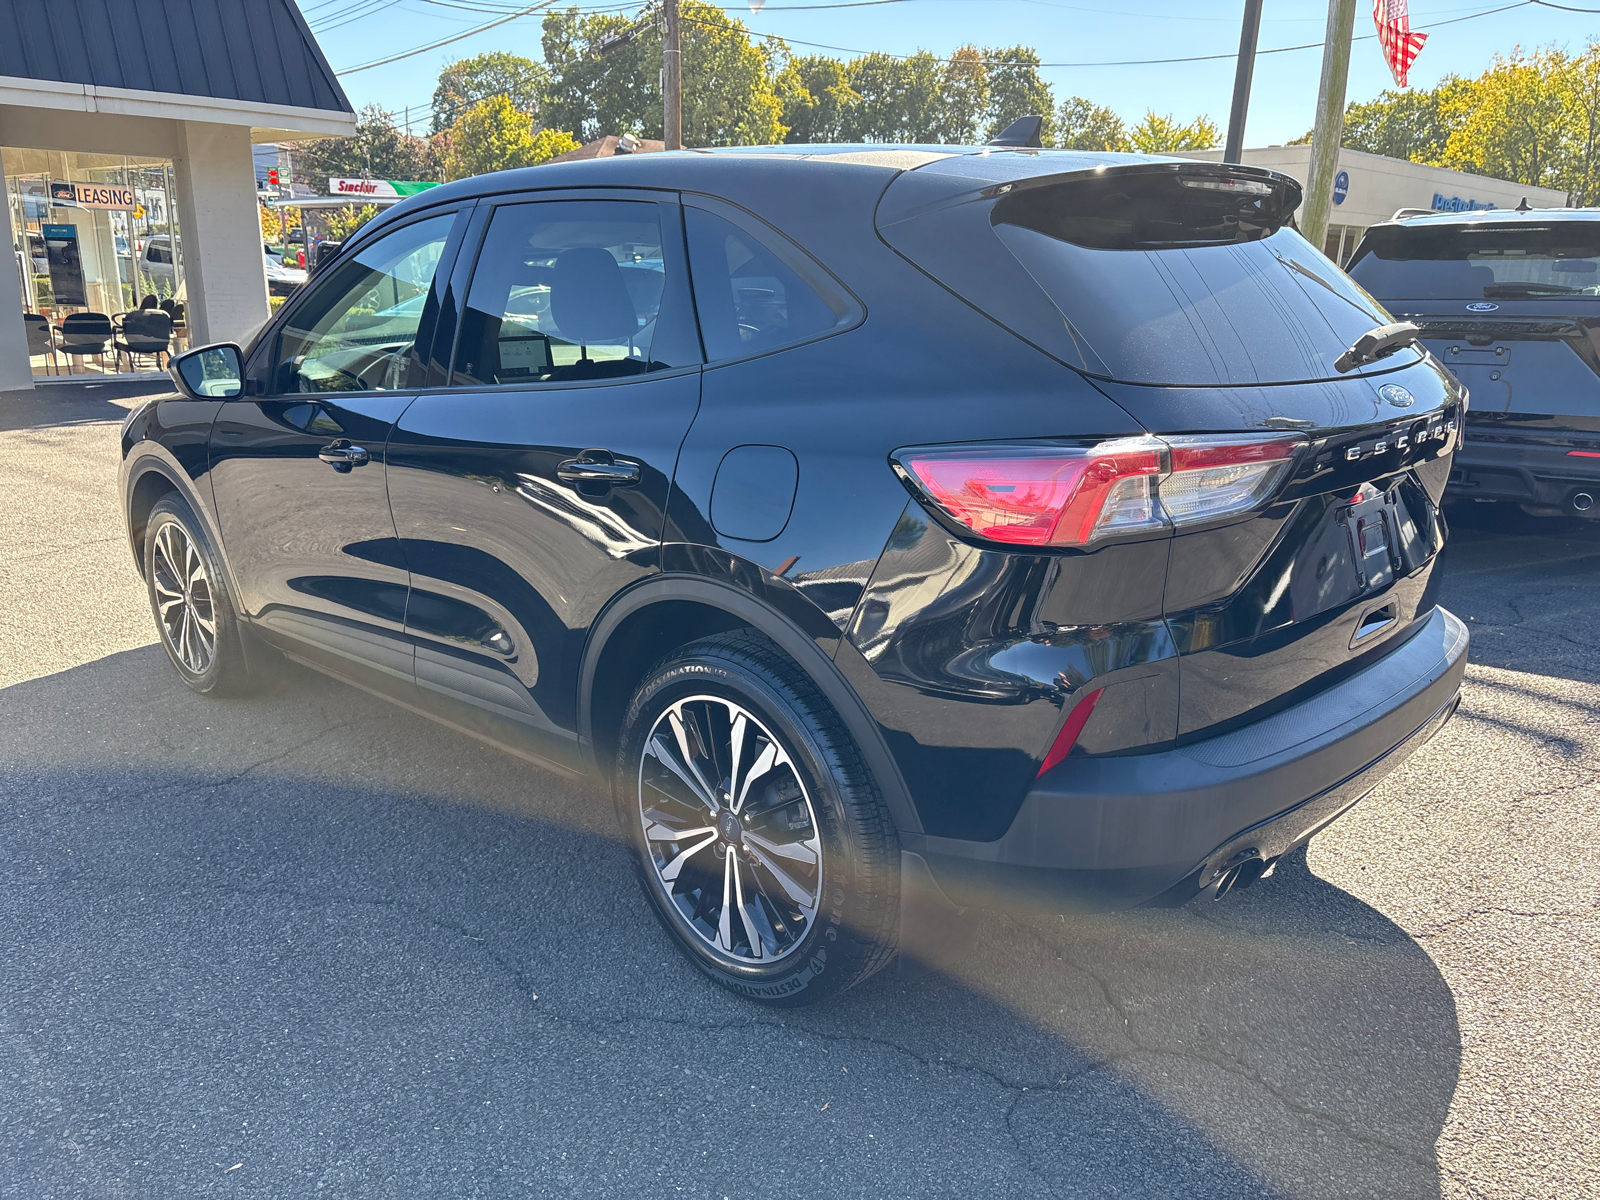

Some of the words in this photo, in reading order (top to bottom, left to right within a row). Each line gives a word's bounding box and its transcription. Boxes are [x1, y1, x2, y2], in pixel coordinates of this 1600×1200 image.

[76, 188, 133, 205] LEASING
[1345, 421, 1454, 460] ESCAPE
[645, 665, 711, 696] DESTINATION
[726, 977, 803, 997] DESTINATION
